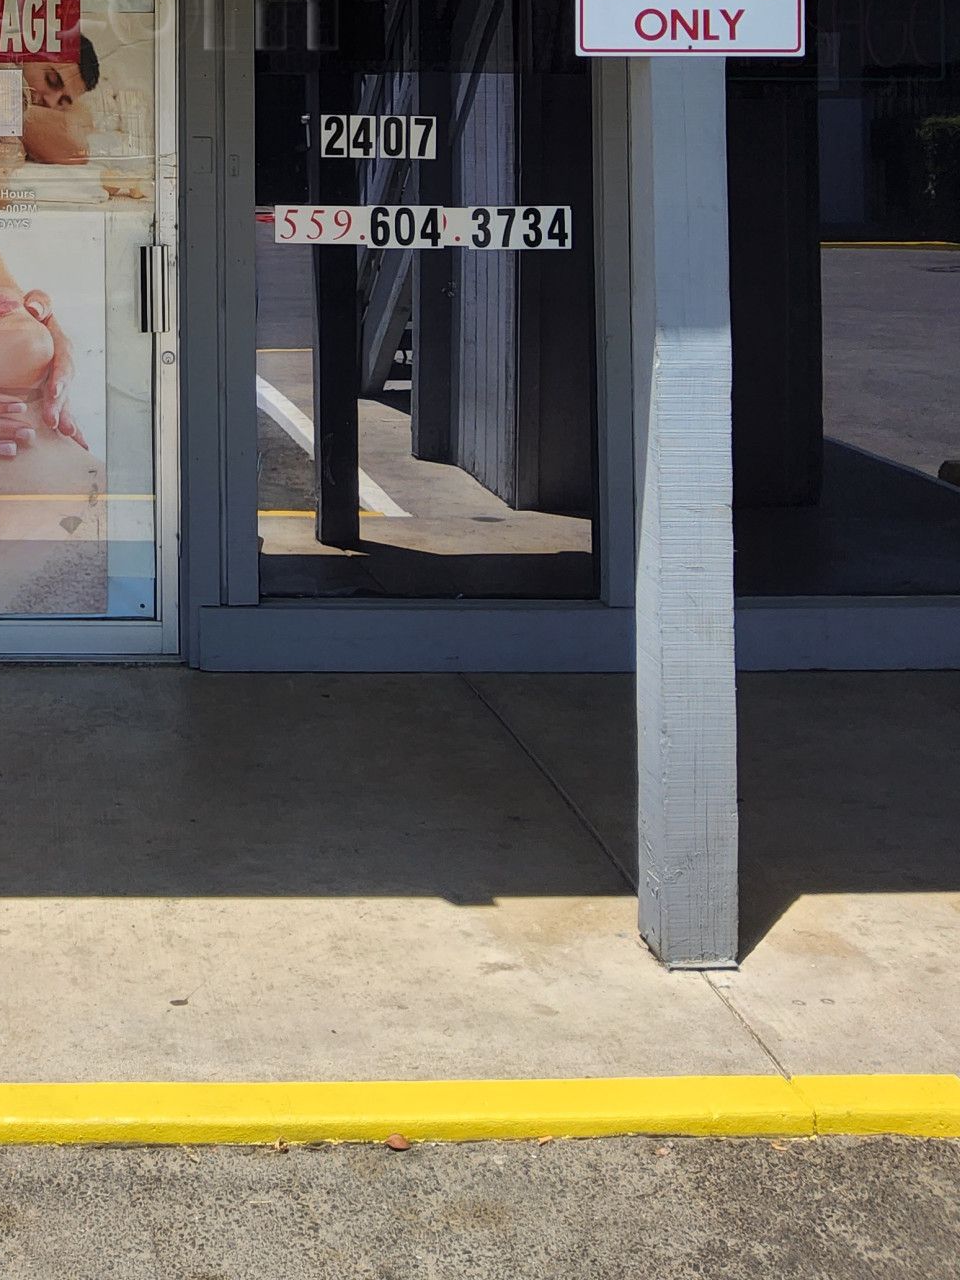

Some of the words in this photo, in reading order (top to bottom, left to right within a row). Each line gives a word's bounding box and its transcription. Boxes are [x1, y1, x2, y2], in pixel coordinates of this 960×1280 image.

[634, 8, 745, 41] ONLY
[323, 115, 434, 157] 2407
[0, 189, 36, 200] Hours
